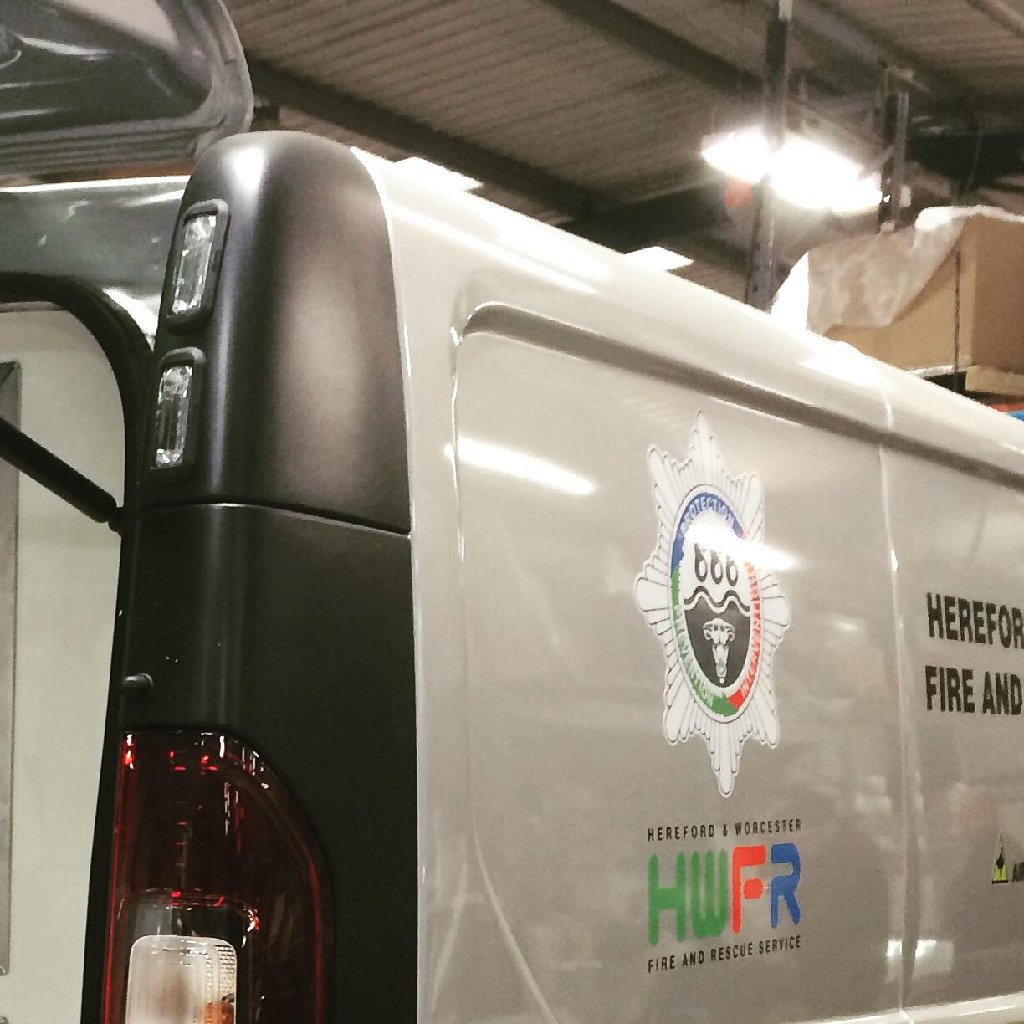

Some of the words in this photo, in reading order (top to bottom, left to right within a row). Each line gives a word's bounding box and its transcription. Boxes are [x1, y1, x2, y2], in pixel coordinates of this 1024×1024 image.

[925, 665, 975, 713] FIRE
[982, 671, 1023, 715] AND
[648, 824, 715, 842] HEREFORD
[735, 818, 802, 836] WORCESTER
[648, 955, 675, 973] FIRE
[682, 950, 705, 967] AND
[710, 942, 753, 961] RESCUE
[759, 935, 802, 954] SERVICE
